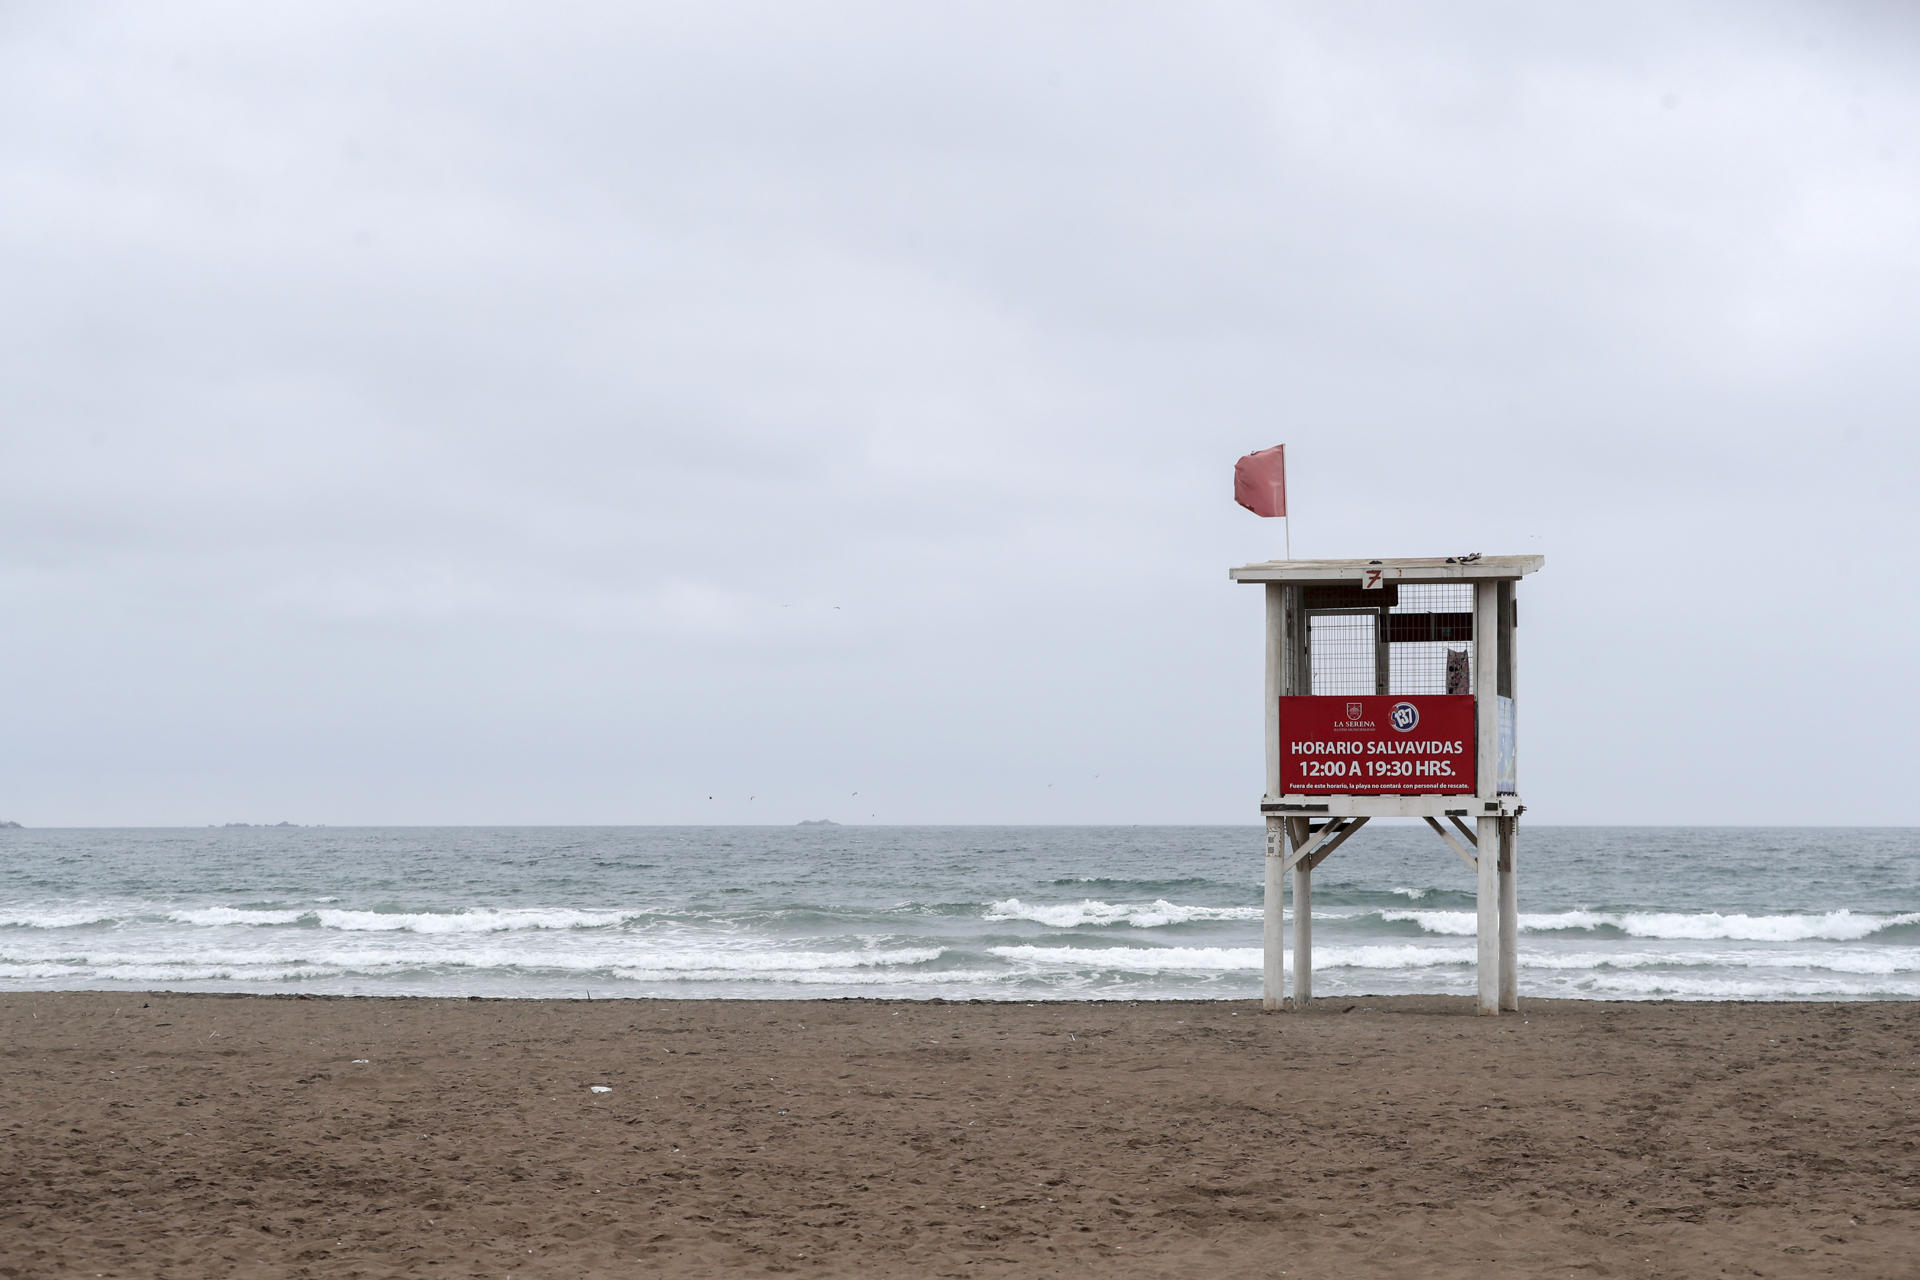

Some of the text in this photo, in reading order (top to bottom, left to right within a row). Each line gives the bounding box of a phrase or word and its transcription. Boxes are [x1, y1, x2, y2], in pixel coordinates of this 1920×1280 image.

[1366, 570, 1381, 588] 7
[1291, 741, 1463, 754] HORARIO SALVAVIDAS
[1299, 761, 1456, 776] 12:00 A 19:30 HRS.
